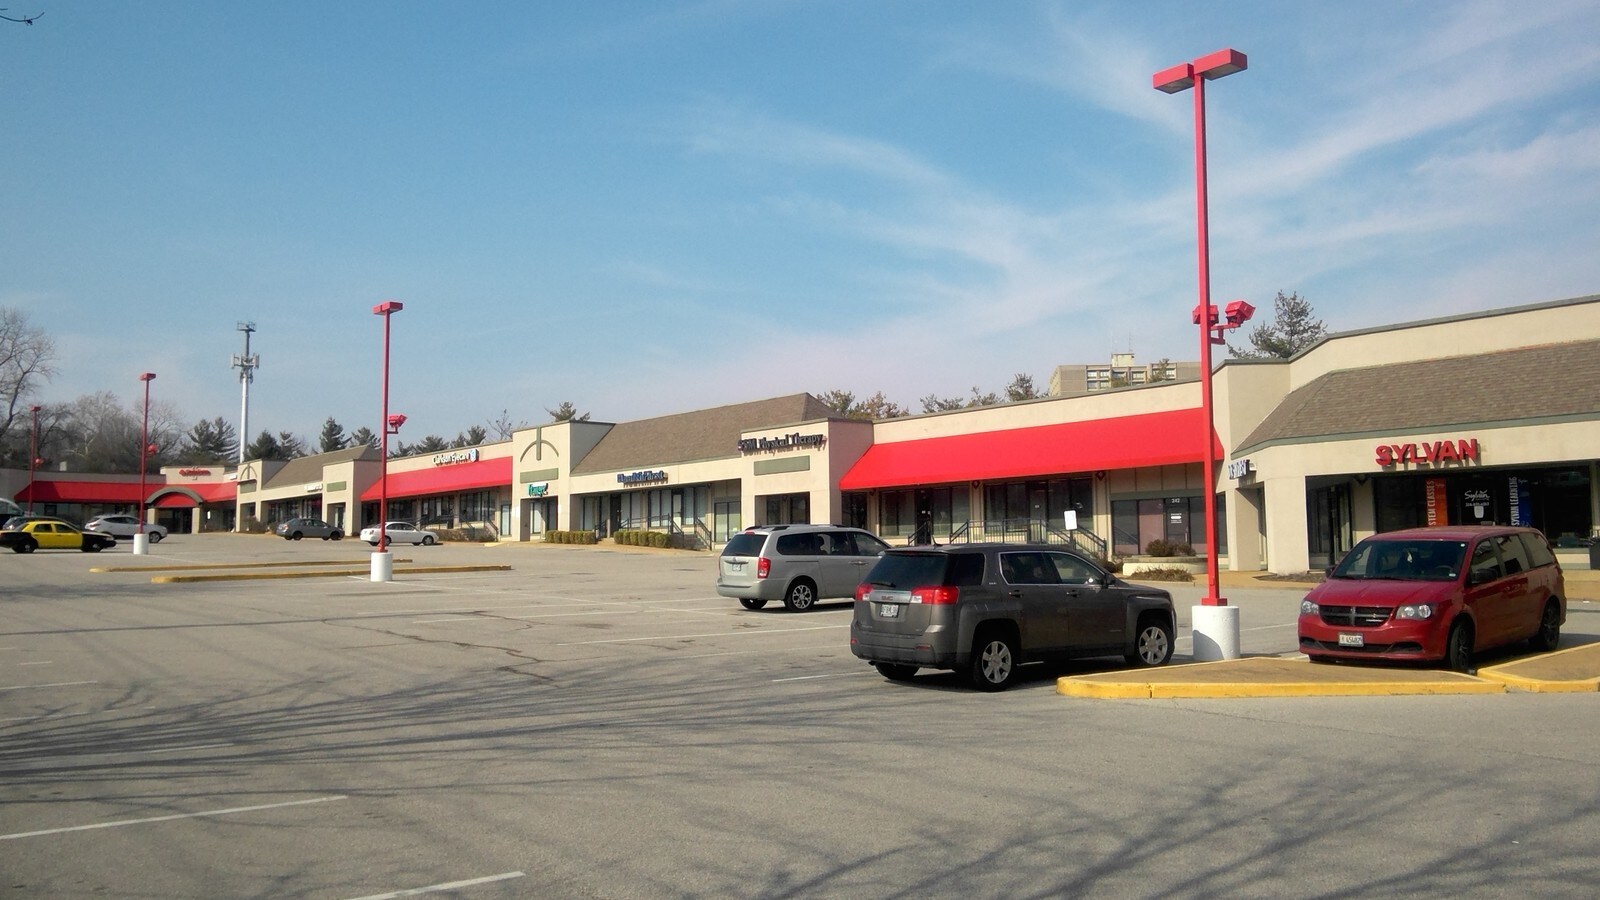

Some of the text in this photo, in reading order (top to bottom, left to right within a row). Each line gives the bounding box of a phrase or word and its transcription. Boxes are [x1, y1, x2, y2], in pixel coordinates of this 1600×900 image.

[790, 432, 823, 446] Therapy
[1375, 439, 1478, 466] SYLVAN
[1426, 480, 1436, 526] STEM CLASSES
